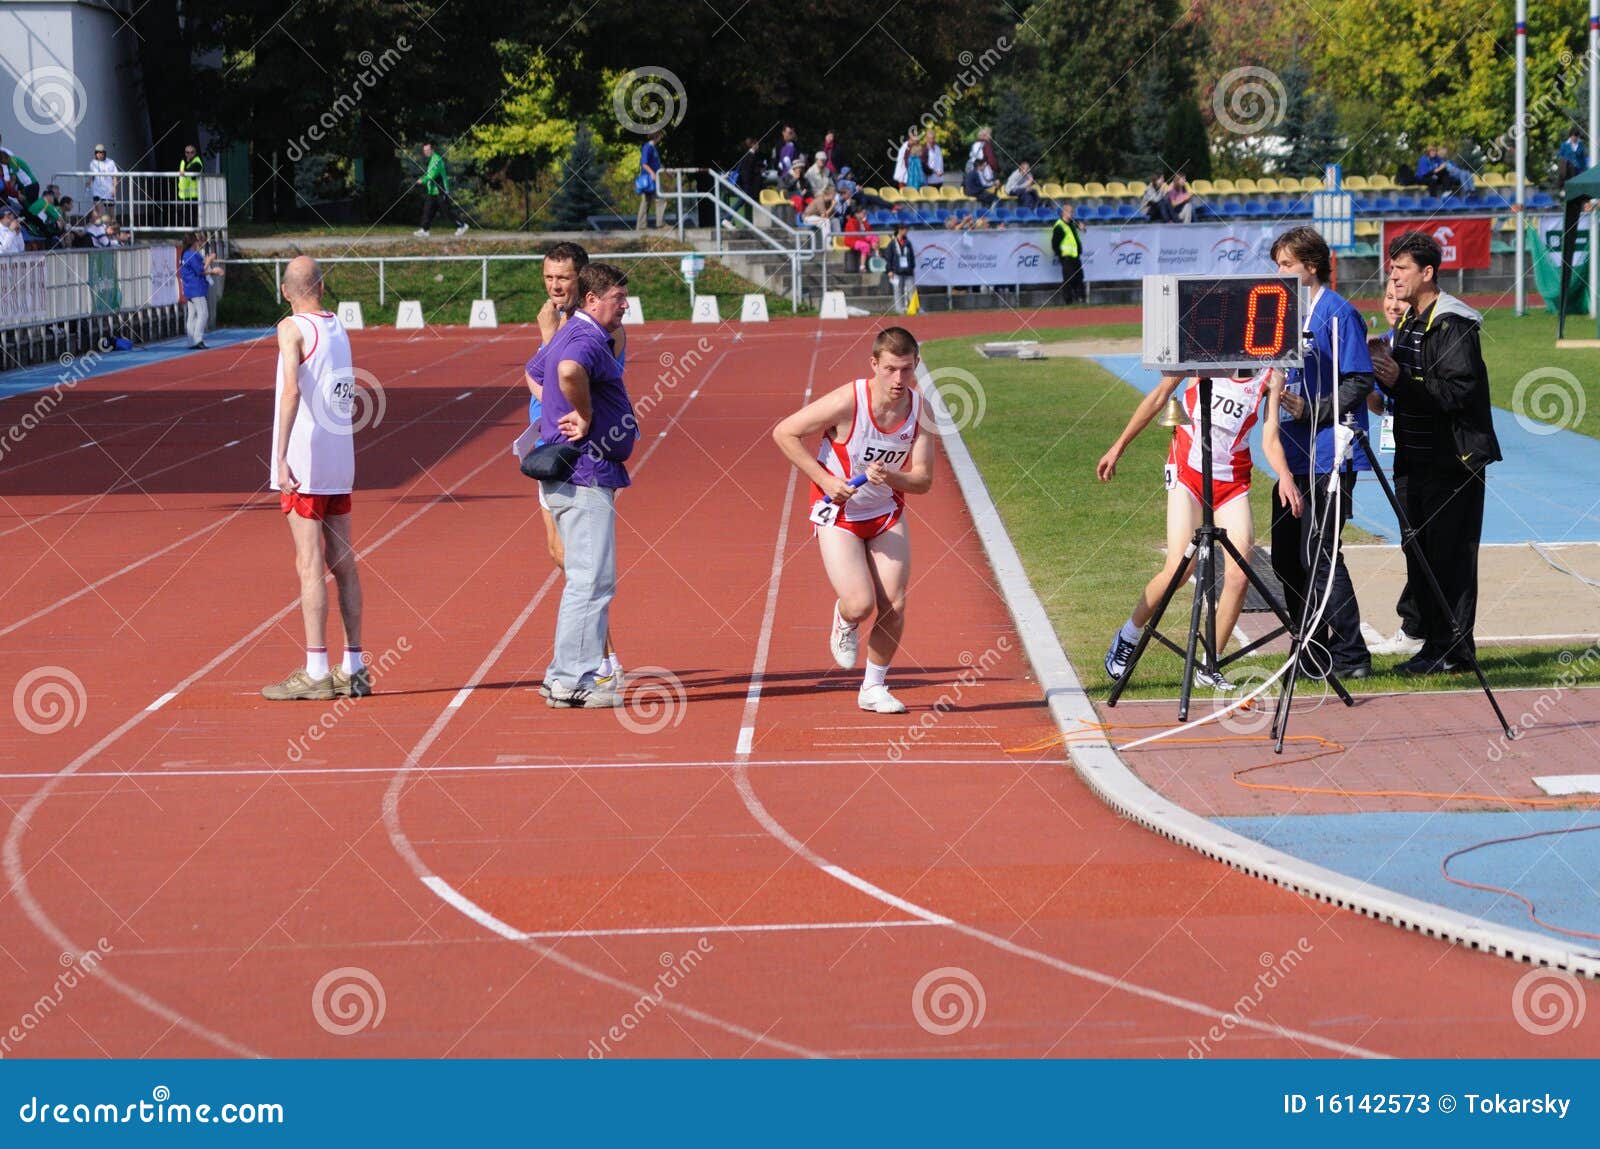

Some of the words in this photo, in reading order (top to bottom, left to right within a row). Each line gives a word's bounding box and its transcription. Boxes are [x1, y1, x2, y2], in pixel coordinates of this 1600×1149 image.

[1017, 255, 1040, 267] PGE
[1116, 252, 1142, 265] PGE
[1217, 249, 1245, 262] PGE
[920, 257, 946, 270] PGE
[345, 308, 354, 322] 8
[406, 308, 414, 322] 7
[478, 307, 487, 321] 6
[701, 304, 711, 317] 3
[751, 301, 761, 315] 2
[1245, 285, 1287, 356] 0
[1211, 394, 1245, 419] 703
[863, 446, 906, 464] 5707
[817, 506, 833, 523] 4
